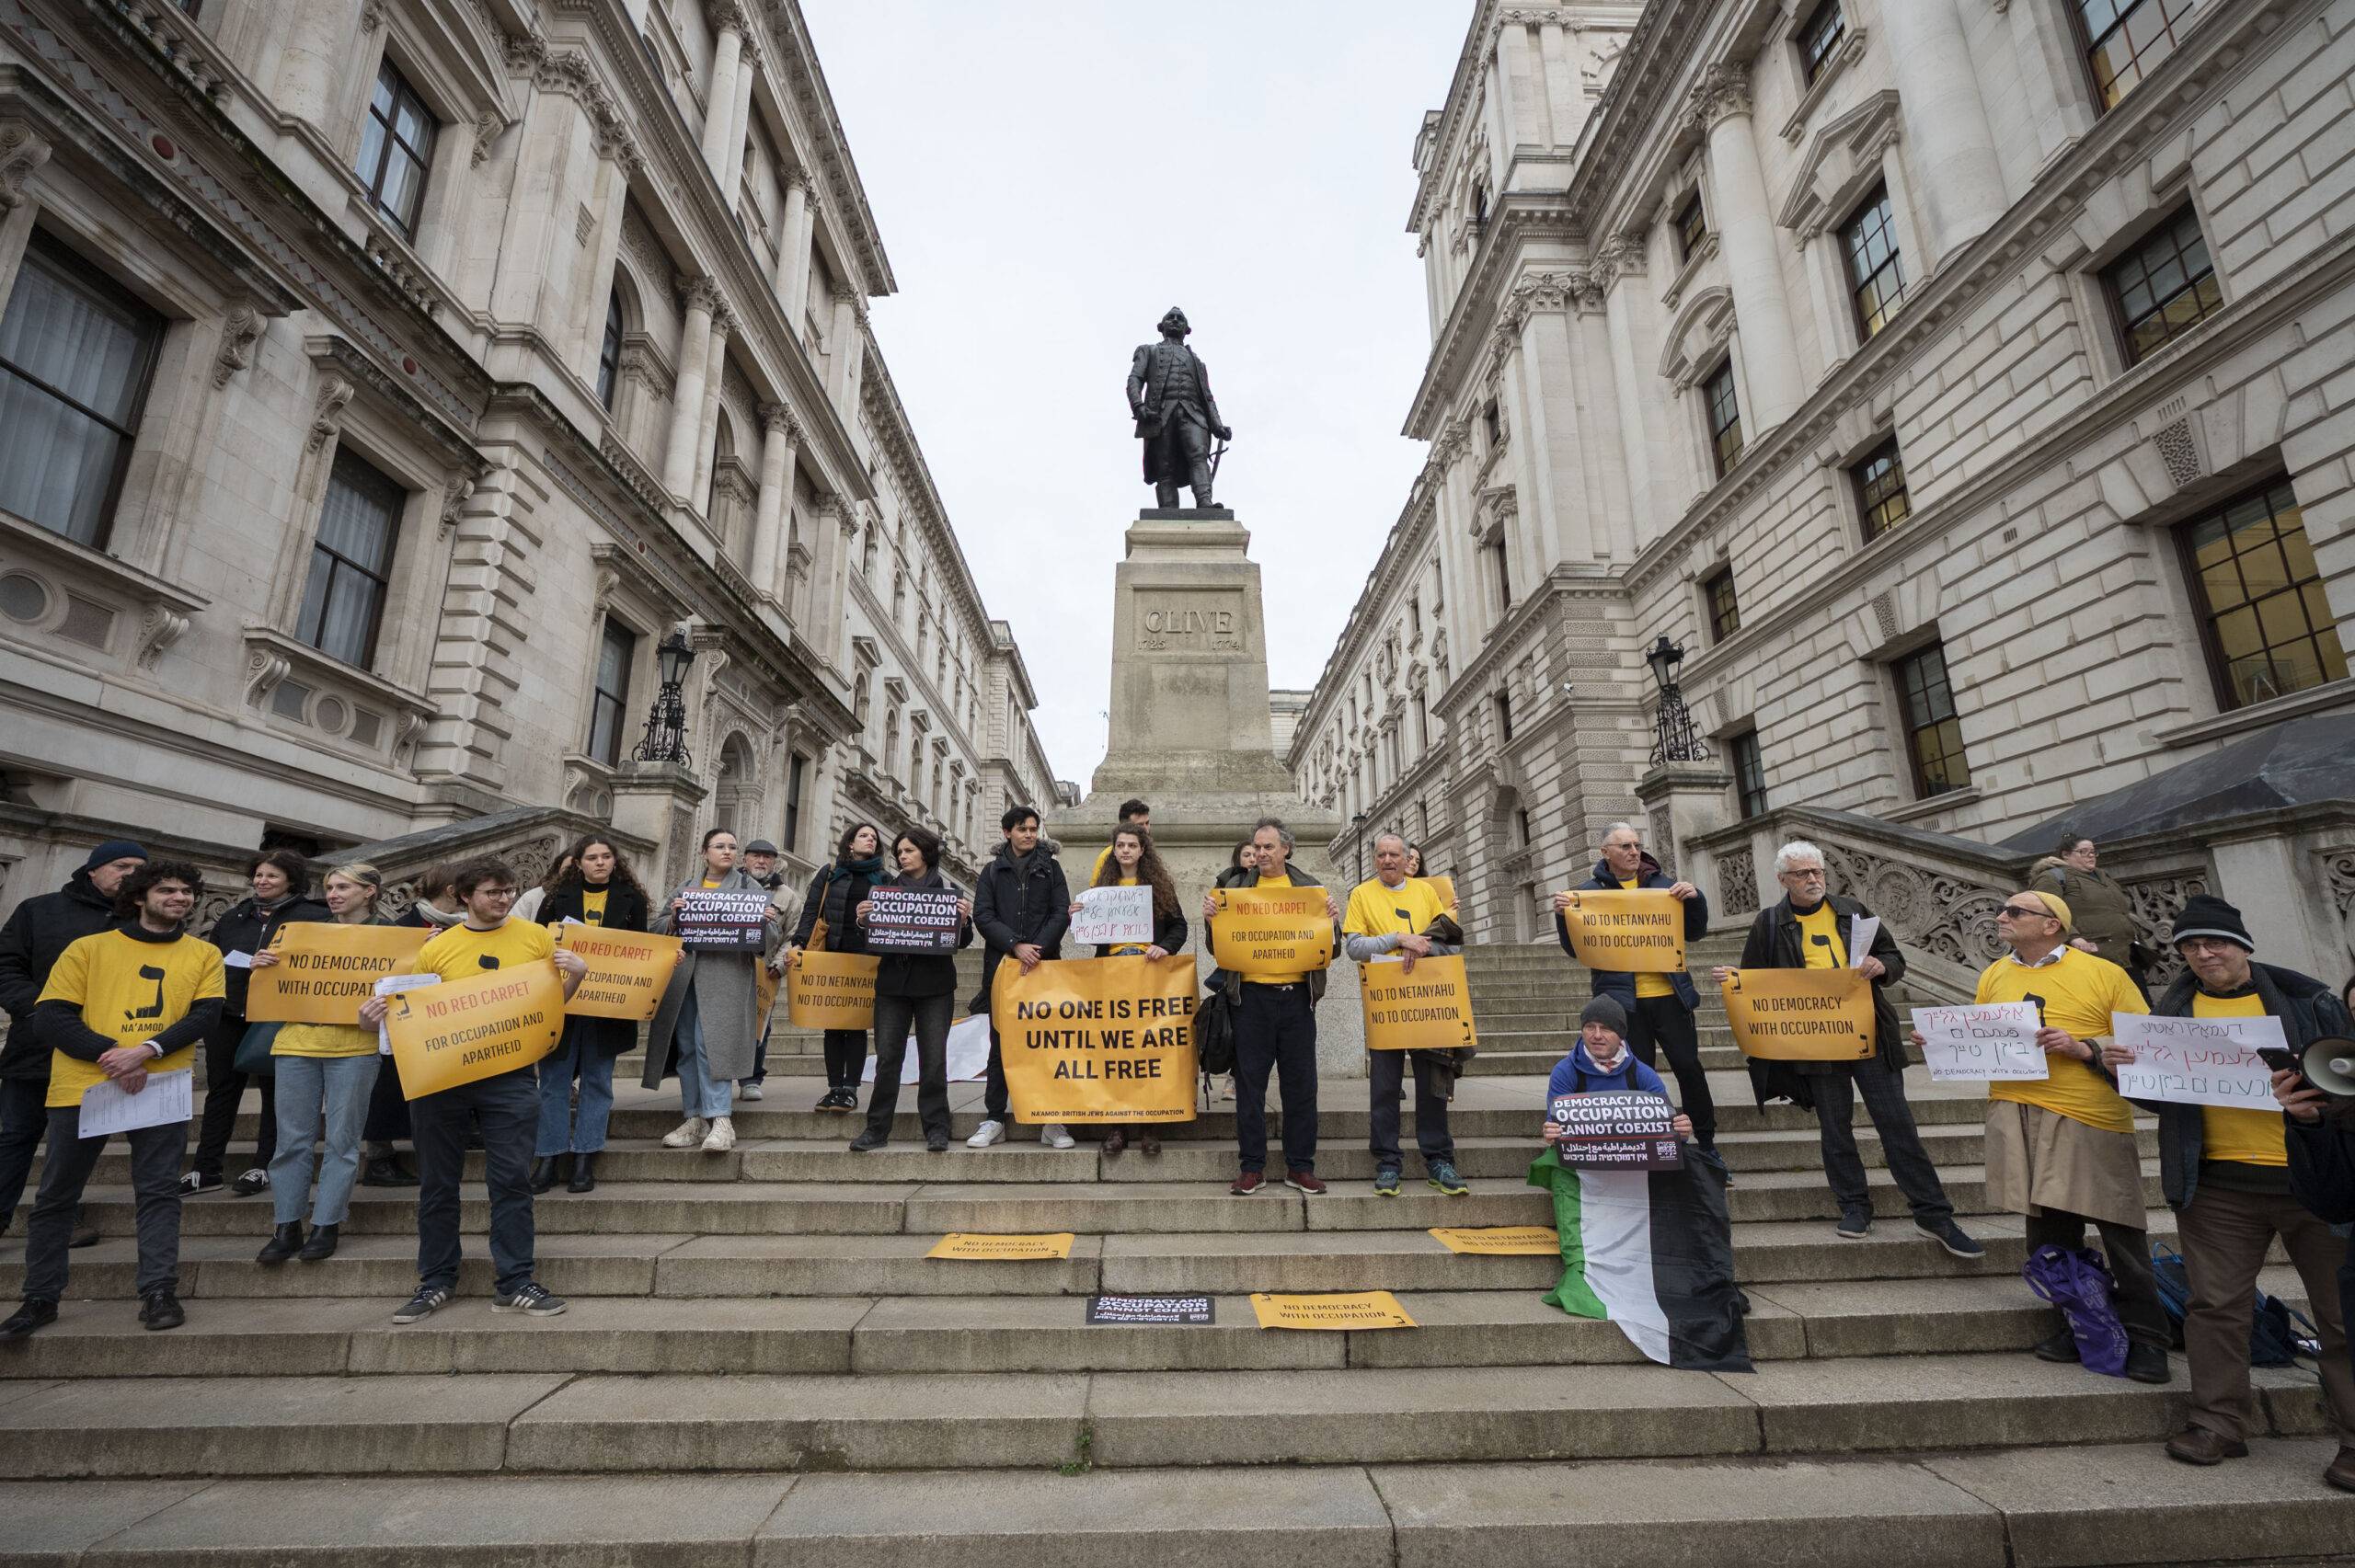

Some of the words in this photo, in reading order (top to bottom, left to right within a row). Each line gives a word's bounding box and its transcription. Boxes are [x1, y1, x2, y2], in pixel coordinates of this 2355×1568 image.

[1144, 611, 1233, 634] CLIVE
[682, 891, 743, 901] DEMOCRACY
[743, 894, 767, 902] AND
[872, 891, 934, 902] DEMOCRACY
[935, 894, 957, 903] AND
[681, 900, 765, 913] OCCUPATION
[872, 901, 957, 915] OCCUPATION
[1236, 903, 1250, 915] NO
[1253, 903, 1270, 915] RED
[1272, 902, 1307, 915] CARPET
[679, 913, 719, 922] CANNOT
[721, 913, 764, 922] COEXIST
[869, 913, 913, 923] CANNOT
[913, 916, 957, 926] COEXIST
[1583, 914, 1596, 926] NO
[1599, 914, 1610, 926] TO
[1613, 913, 1671, 926] NETANYAHU
[1232, 931, 1246, 942] FOR
[1247, 931, 1296, 942] OCCUPATION
[1298, 930, 1315, 941] AND
[1583, 935, 1596, 947] NO
[1599, 935, 1611, 947] TO
[1614, 935, 1674, 947] OCCUPATION
[571, 940, 588, 954] NO
[591, 942, 611, 956] RED
[614, 944, 653, 962] CARPET
[1252, 948, 1295, 960] APARTHEID
[289, 955, 309, 969] NO
[312, 955, 396, 972] DEMOCRACY
[583, 970, 632, 986] CCUPATION
[634, 977, 653, 988] AND
[801, 974, 814, 986] NO
[816, 975, 827, 987] TO
[828, 976, 874, 989] NETANYAH
[278, 979, 309, 995] WITH
[313, 981, 375, 997] OCCUPAT
[1370, 989, 1384, 1001] NO
[1384, 987, 1396, 1001] TO
[1399, 983, 1455, 1000] NETANYAHU
[426, 1001, 447, 1019] NO
[450, 994, 478, 1013] RED
[480, 981, 530, 1006] CARPET
[576, 990, 626, 1004] APARTHEID
[797, 993, 810, 1005] NO
[812, 995, 822, 1006] TO
[1752, 998, 1769, 1012] NO
[1772, 996, 1842, 1012] DEMOCRACY
[1017, 1001, 1051, 1021] NO
[1059, 1000, 1103, 1020] ONE
[1109, 999, 1131, 1019] IS
[1138, 996, 1193, 1018] FREE
[1372, 1011, 1384, 1024] NO
[1387, 1010, 1398, 1023] TO
[1401, 1007, 1460, 1023] OCCUPATION
[121, 1023, 164, 1033] NA'AMOD
[425, 1036, 449, 1052] FOR
[452, 1016, 521, 1046] OCCUPATION
[523, 1011, 544, 1028] AND
[1748, 1022, 1777, 1036] WITH
[1780, 1020, 1854, 1036] OCCUPATION
[1026, 1030, 1096, 1049] UNTIL
[1100, 1029, 1134, 1049] WE
[1142, 1026, 1189, 1048] ARE
[462, 1039, 523, 1067] APARTHEID
[1053, 1059, 1098, 1080] ALL
[1105, 1059, 1162, 1080] FREE
[1946, 1068, 1986, 1078] DEMOCRACY
[1554, 1096, 1632, 1108] DEMOCRACY
[1635, 1095, 1665, 1104] AND
[1556, 1105, 1670, 1123] OCCUPATION
[1559, 1123, 1613, 1135] CANNOT
[1615, 1121, 1671, 1134] COEXIST
[1637, 1153, 1648, 1162] אין
[1303, 1302, 1373, 1310] DEMOCRACY
